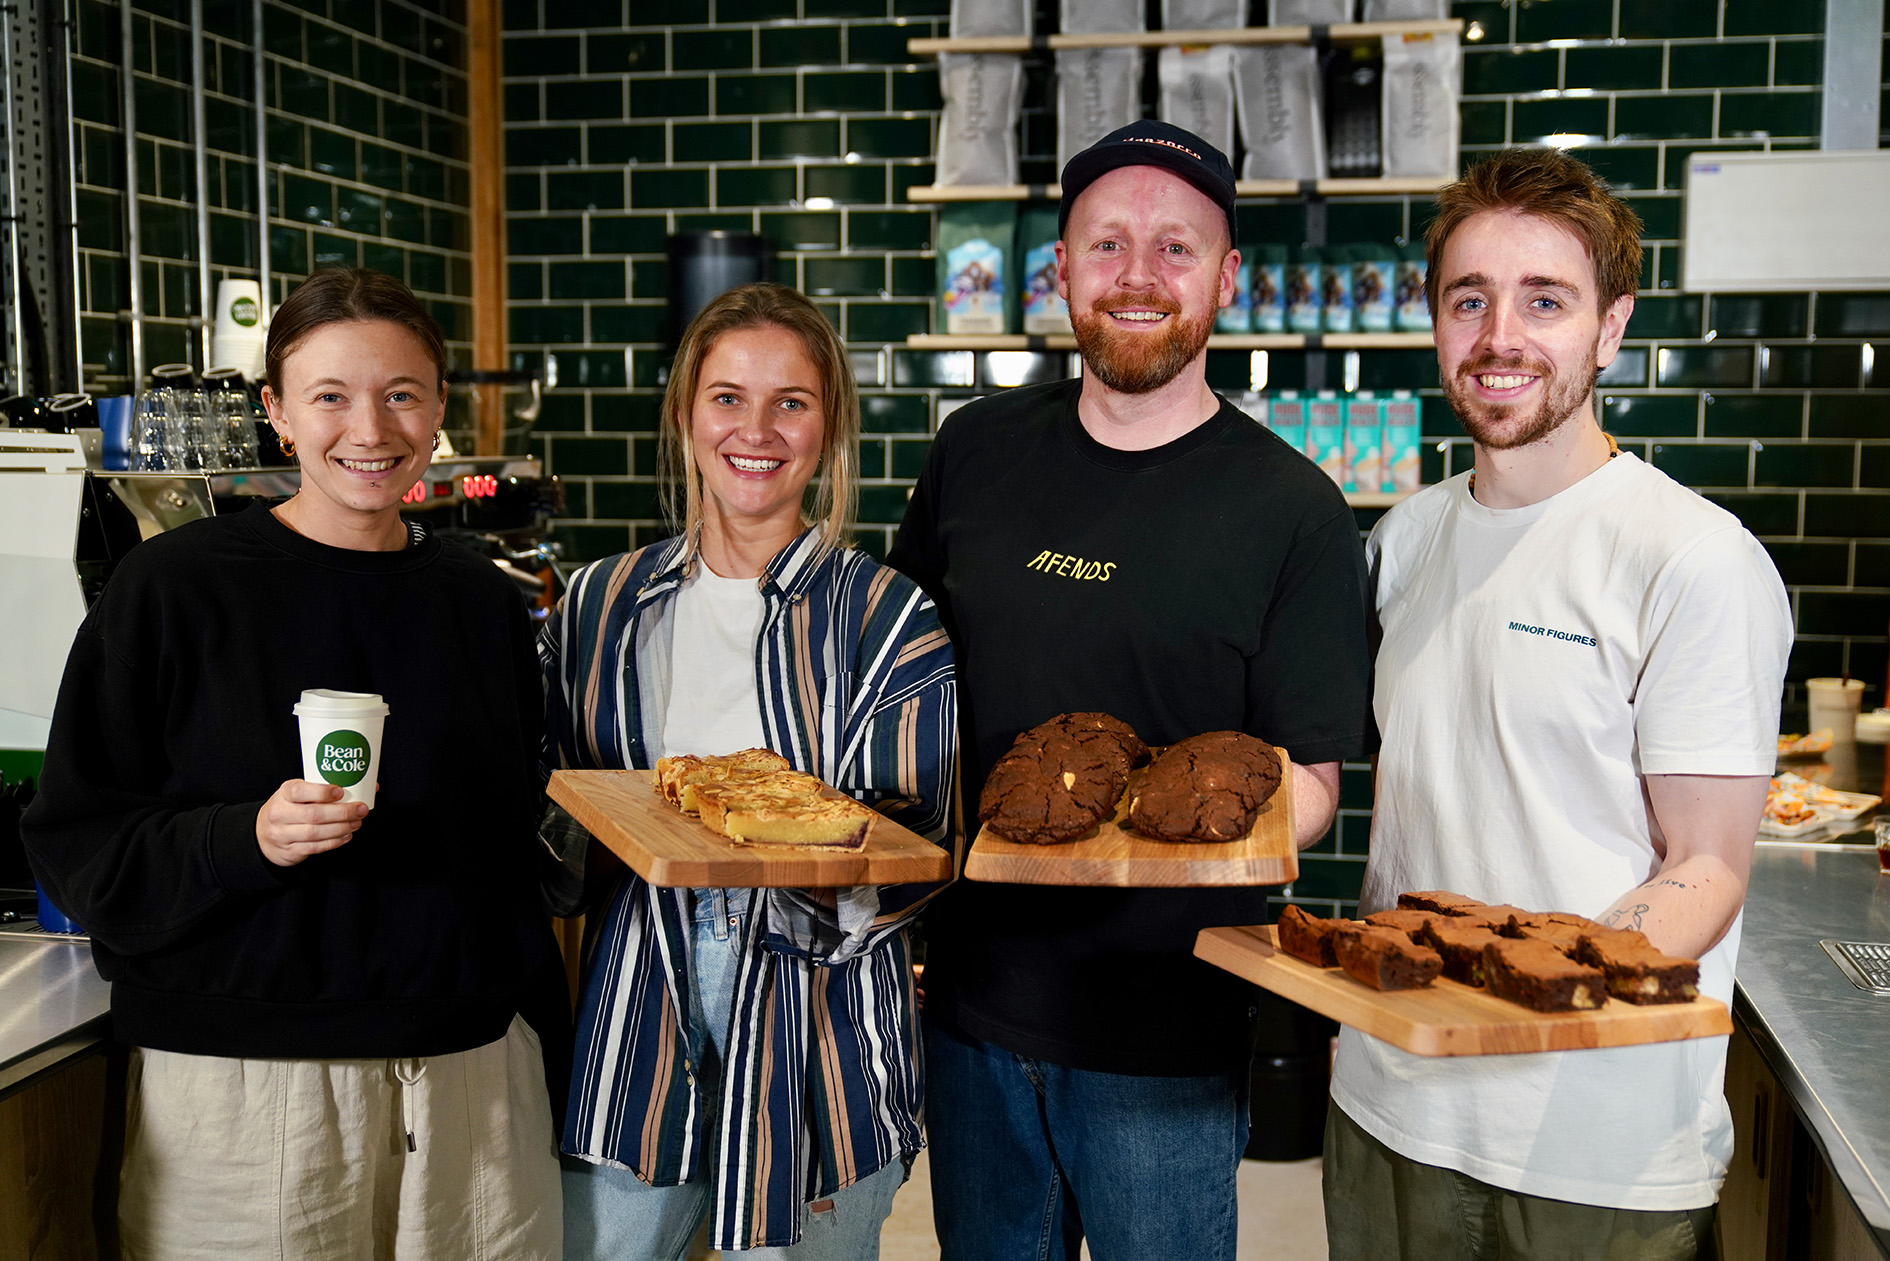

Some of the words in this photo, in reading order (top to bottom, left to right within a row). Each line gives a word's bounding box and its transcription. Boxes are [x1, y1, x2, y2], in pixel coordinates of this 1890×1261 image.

[1026, 550, 1117, 582] AFENDS
[1508, 621, 1545, 636] MINOR
[1546, 628, 1597, 647] FIGURES
[324, 744, 363, 759] Bean
[321, 758, 366, 772] &Cole
